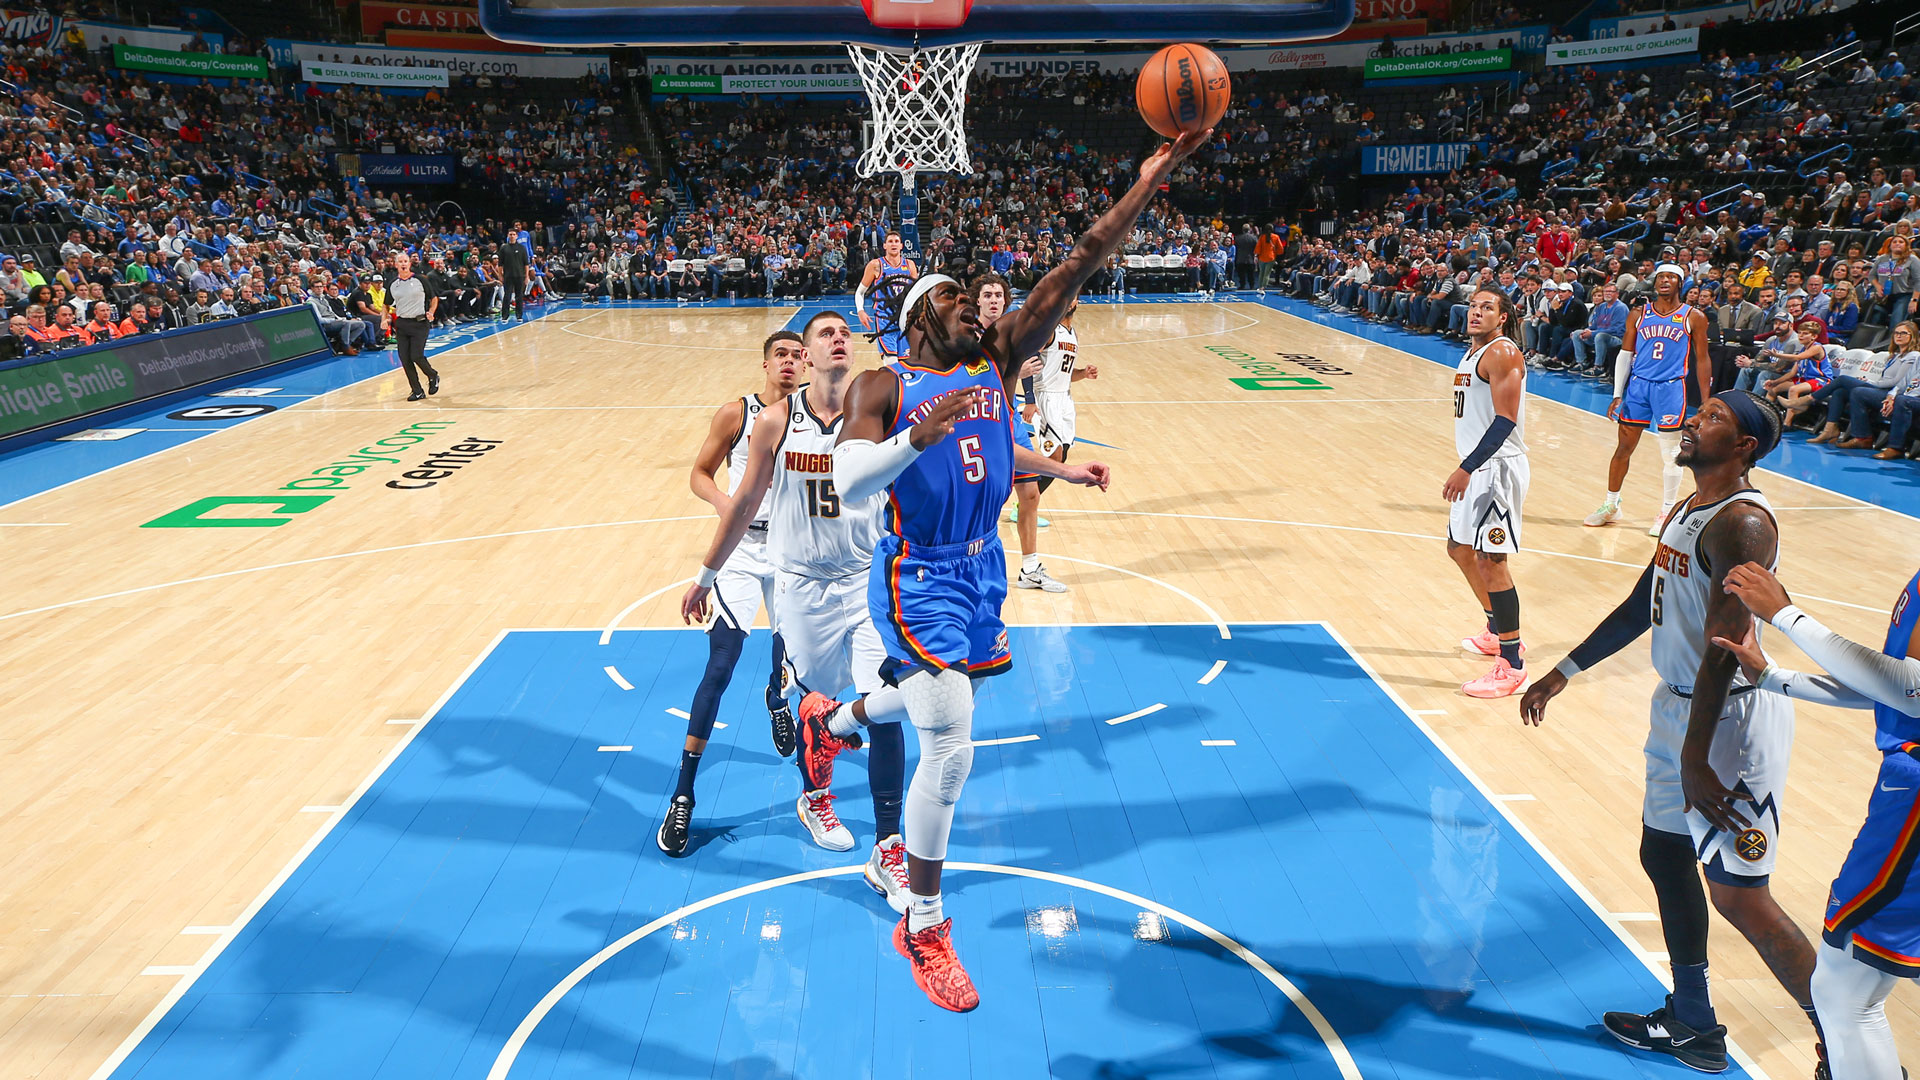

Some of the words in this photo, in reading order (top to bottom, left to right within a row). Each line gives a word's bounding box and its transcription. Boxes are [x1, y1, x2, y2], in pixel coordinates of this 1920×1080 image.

[397, 8, 480, 27] CASIN
[1521, 34, 1545, 49] 102
[1571, 47, 1598, 57] DELTA
[1600, 44, 1634, 55] DENTAL
[1636, 42, 1647, 51] OF
[1648, 36, 1693, 49] OKLAHOMA
[123, 52, 259, 72] DeltaDentalOK.org/CoversMe
[990, 60, 1101, 74] THUNDER
[1268, 50, 1300, 65] Bally
[1374, 55, 1504, 73] DeltaDentalOK.org/CoversMe
[325, 69, 349, 78] DELTA
[350, 71, 381, 80] DENTAL
[396, 73, 444, 81] OKLAHOMA
[730, 80, 776, 89] PROTECT
[780, 79, 807, 88] YOUR
[811, 79, 849, 88] UNIQUE
[1176, 57, 1198, 123] Wilson
[1375, 143, 1471, 173] HOMELAND
[411, 165, 448, 176] ULTRA
[1639, 324, 1685, 343] THUNDER
[138, 336, 265, 376] DeltaDentalOK.org/CoversMe
[1652, 341, 1665, 360] 2
[1060, 353, 1076, 374] 27
[63, 363, 127, 399] Smile
[793, 413, 803, 423] 6
[278, 421, 457, 491] paycom
[385, 436, 504, 490] center
[785, 451, 833, 474] NUGG
[957, 434, 988, 484] 5
[806, 479, 841, 519] 15
[1652, 575, 1665, 627] 5
